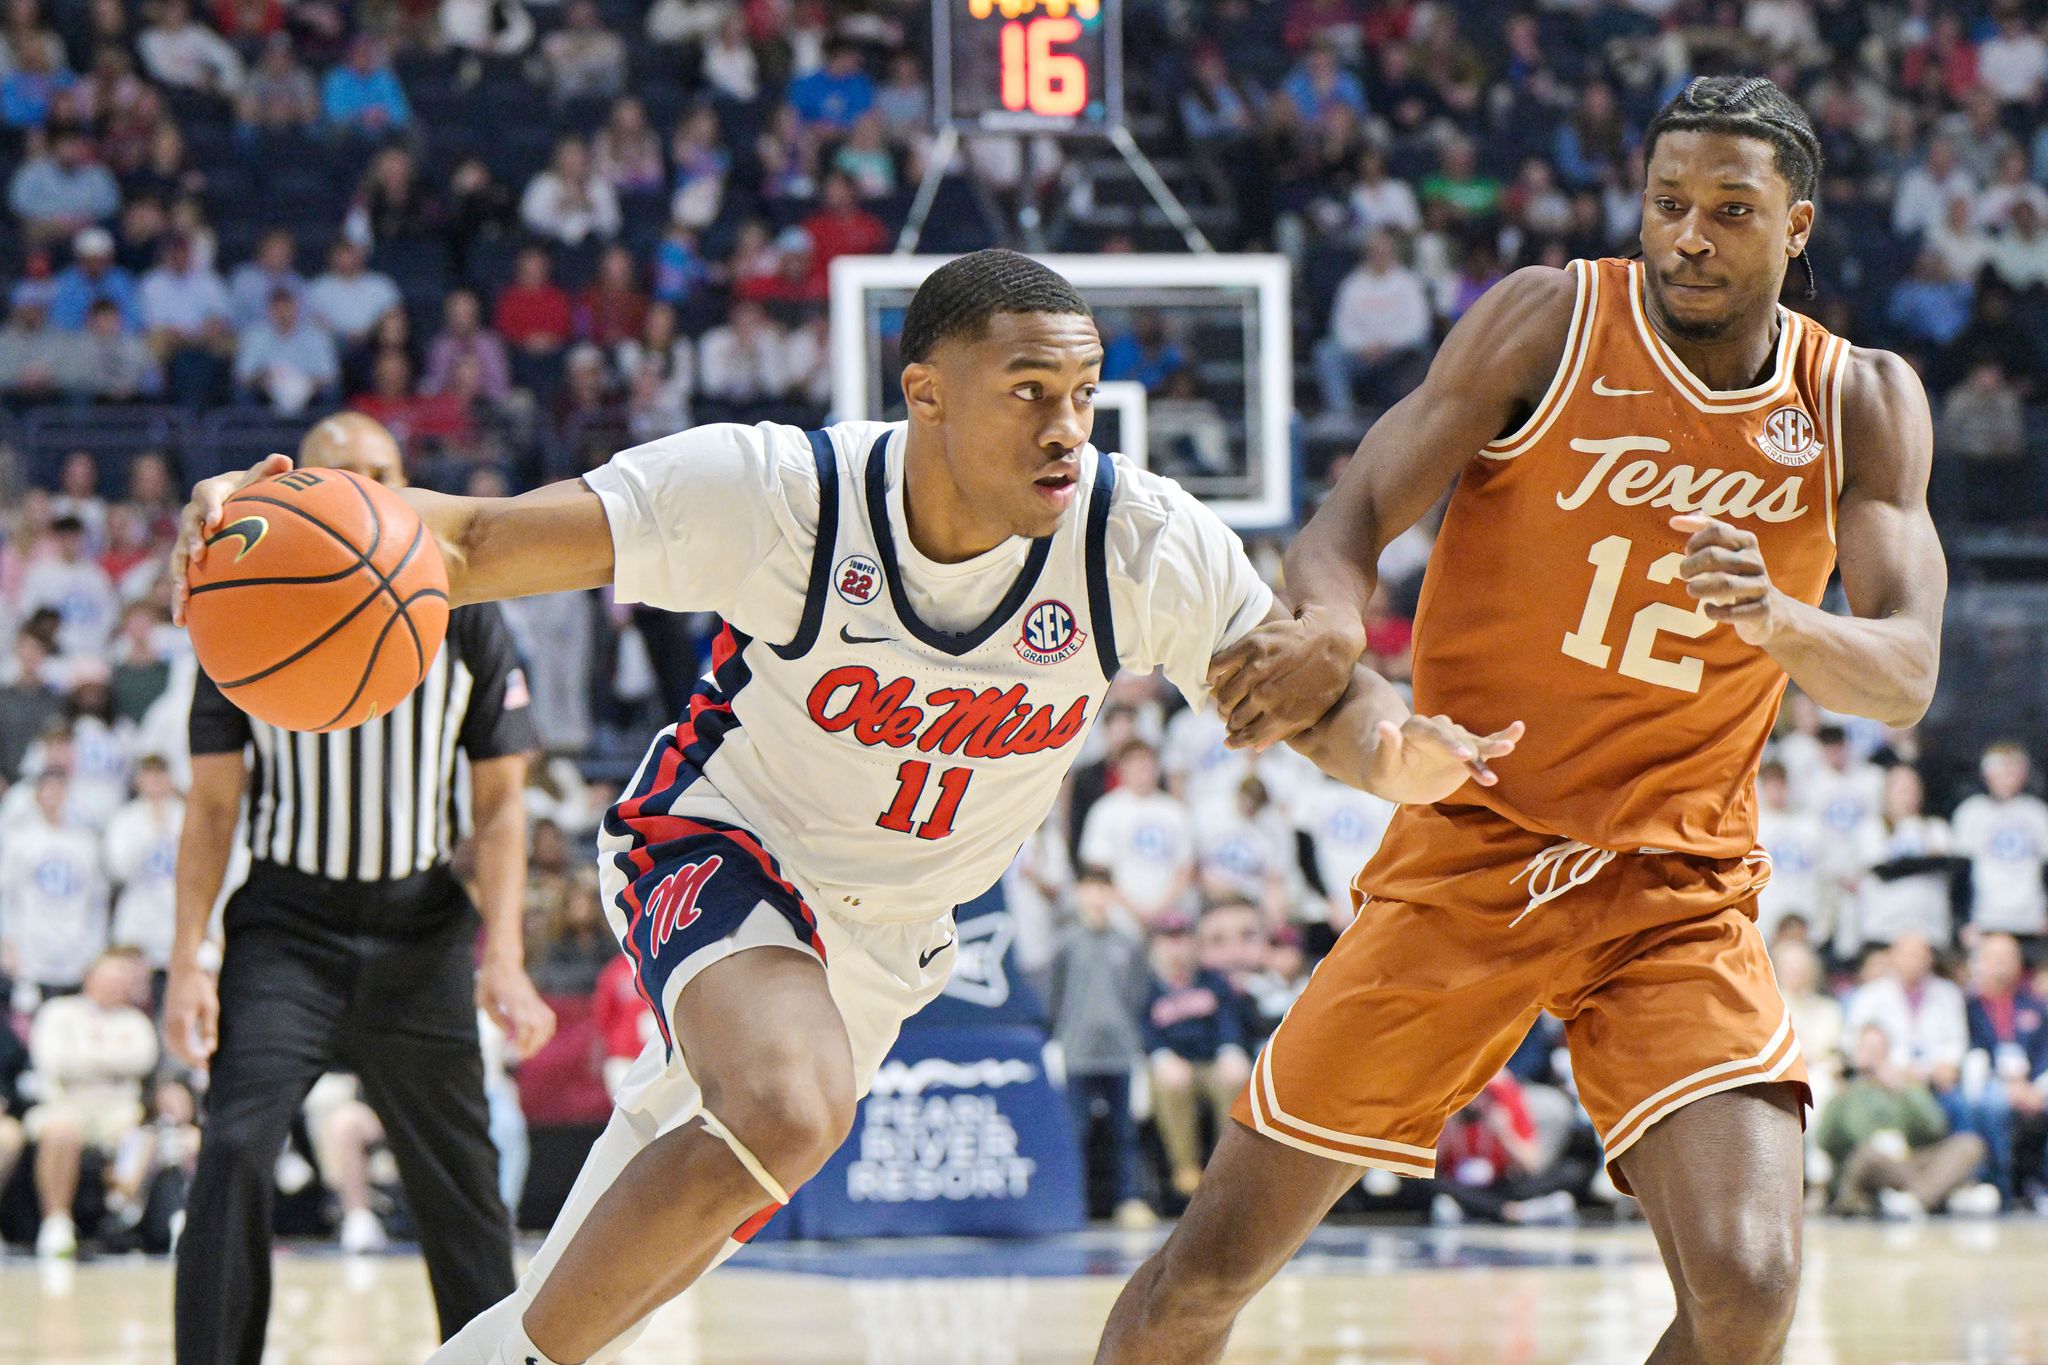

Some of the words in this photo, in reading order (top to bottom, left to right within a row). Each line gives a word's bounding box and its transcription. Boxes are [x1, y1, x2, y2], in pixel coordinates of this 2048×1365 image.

[1001, 16, 1087, 116] 16
[1768, 410, 1811, 452] SEC
[1763, 445, 1816, 466] GRADUATE
[1556, 435, 1809, 523] Texas
[840, 569, 873, 600] 22
[849, 559, 876, 575] JUMPER
[1026, 604, 1071, 650] SEC
[1561, 534, 1736, 693] 12
[1023, 642, 1078, 664] GRADUATE
[806, 665, 924, 749] Ole
[917, 683, 1090, 759] Miss
[876, 759, 974, 840] 11
